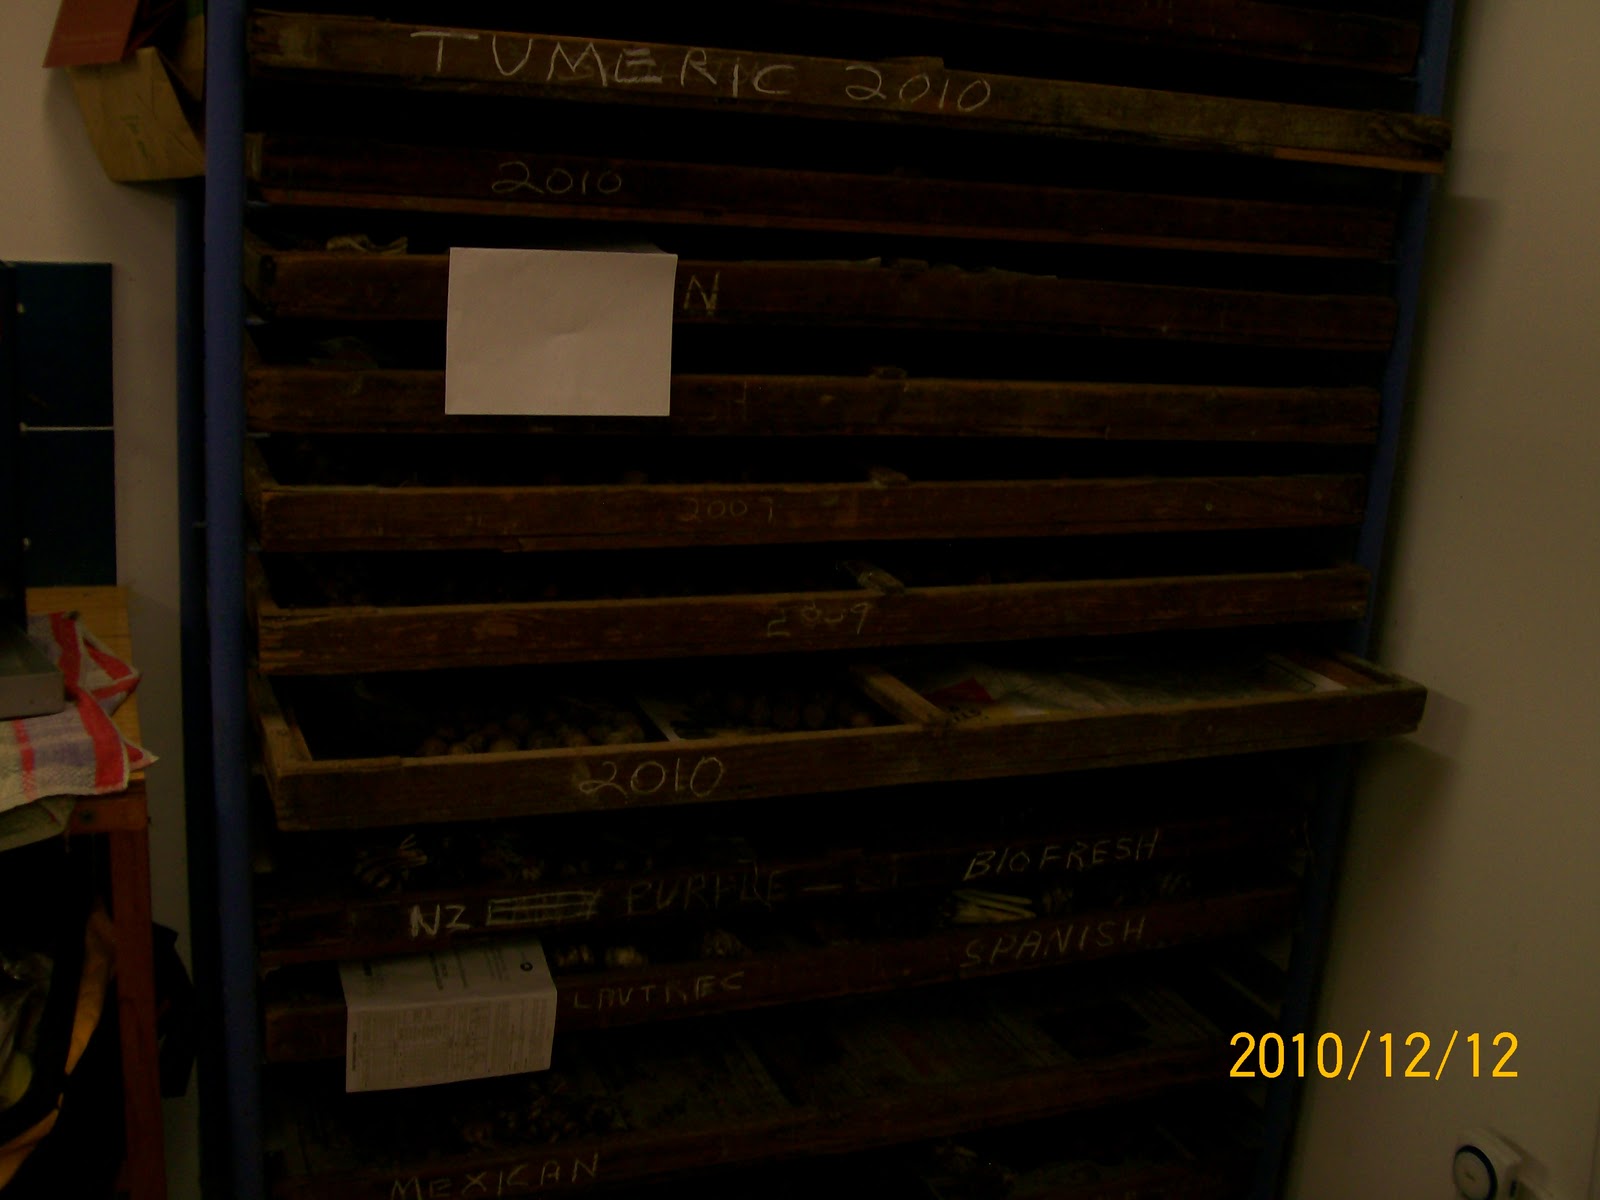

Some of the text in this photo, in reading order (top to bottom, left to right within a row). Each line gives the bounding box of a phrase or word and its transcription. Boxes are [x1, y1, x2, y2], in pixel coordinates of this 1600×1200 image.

[409, 31, 992, 112] TUMERIC 2010
[490, 160, 623, 197] 2010
[577, 755, 727, 799] 2010
[962, 827, 1160, 882] BIOFRESH
[409, 903, 471, 939] NZ
[959, 916, 1147, 968] SPANISH
[390, 1152, 600, 1200] MEXICAN
